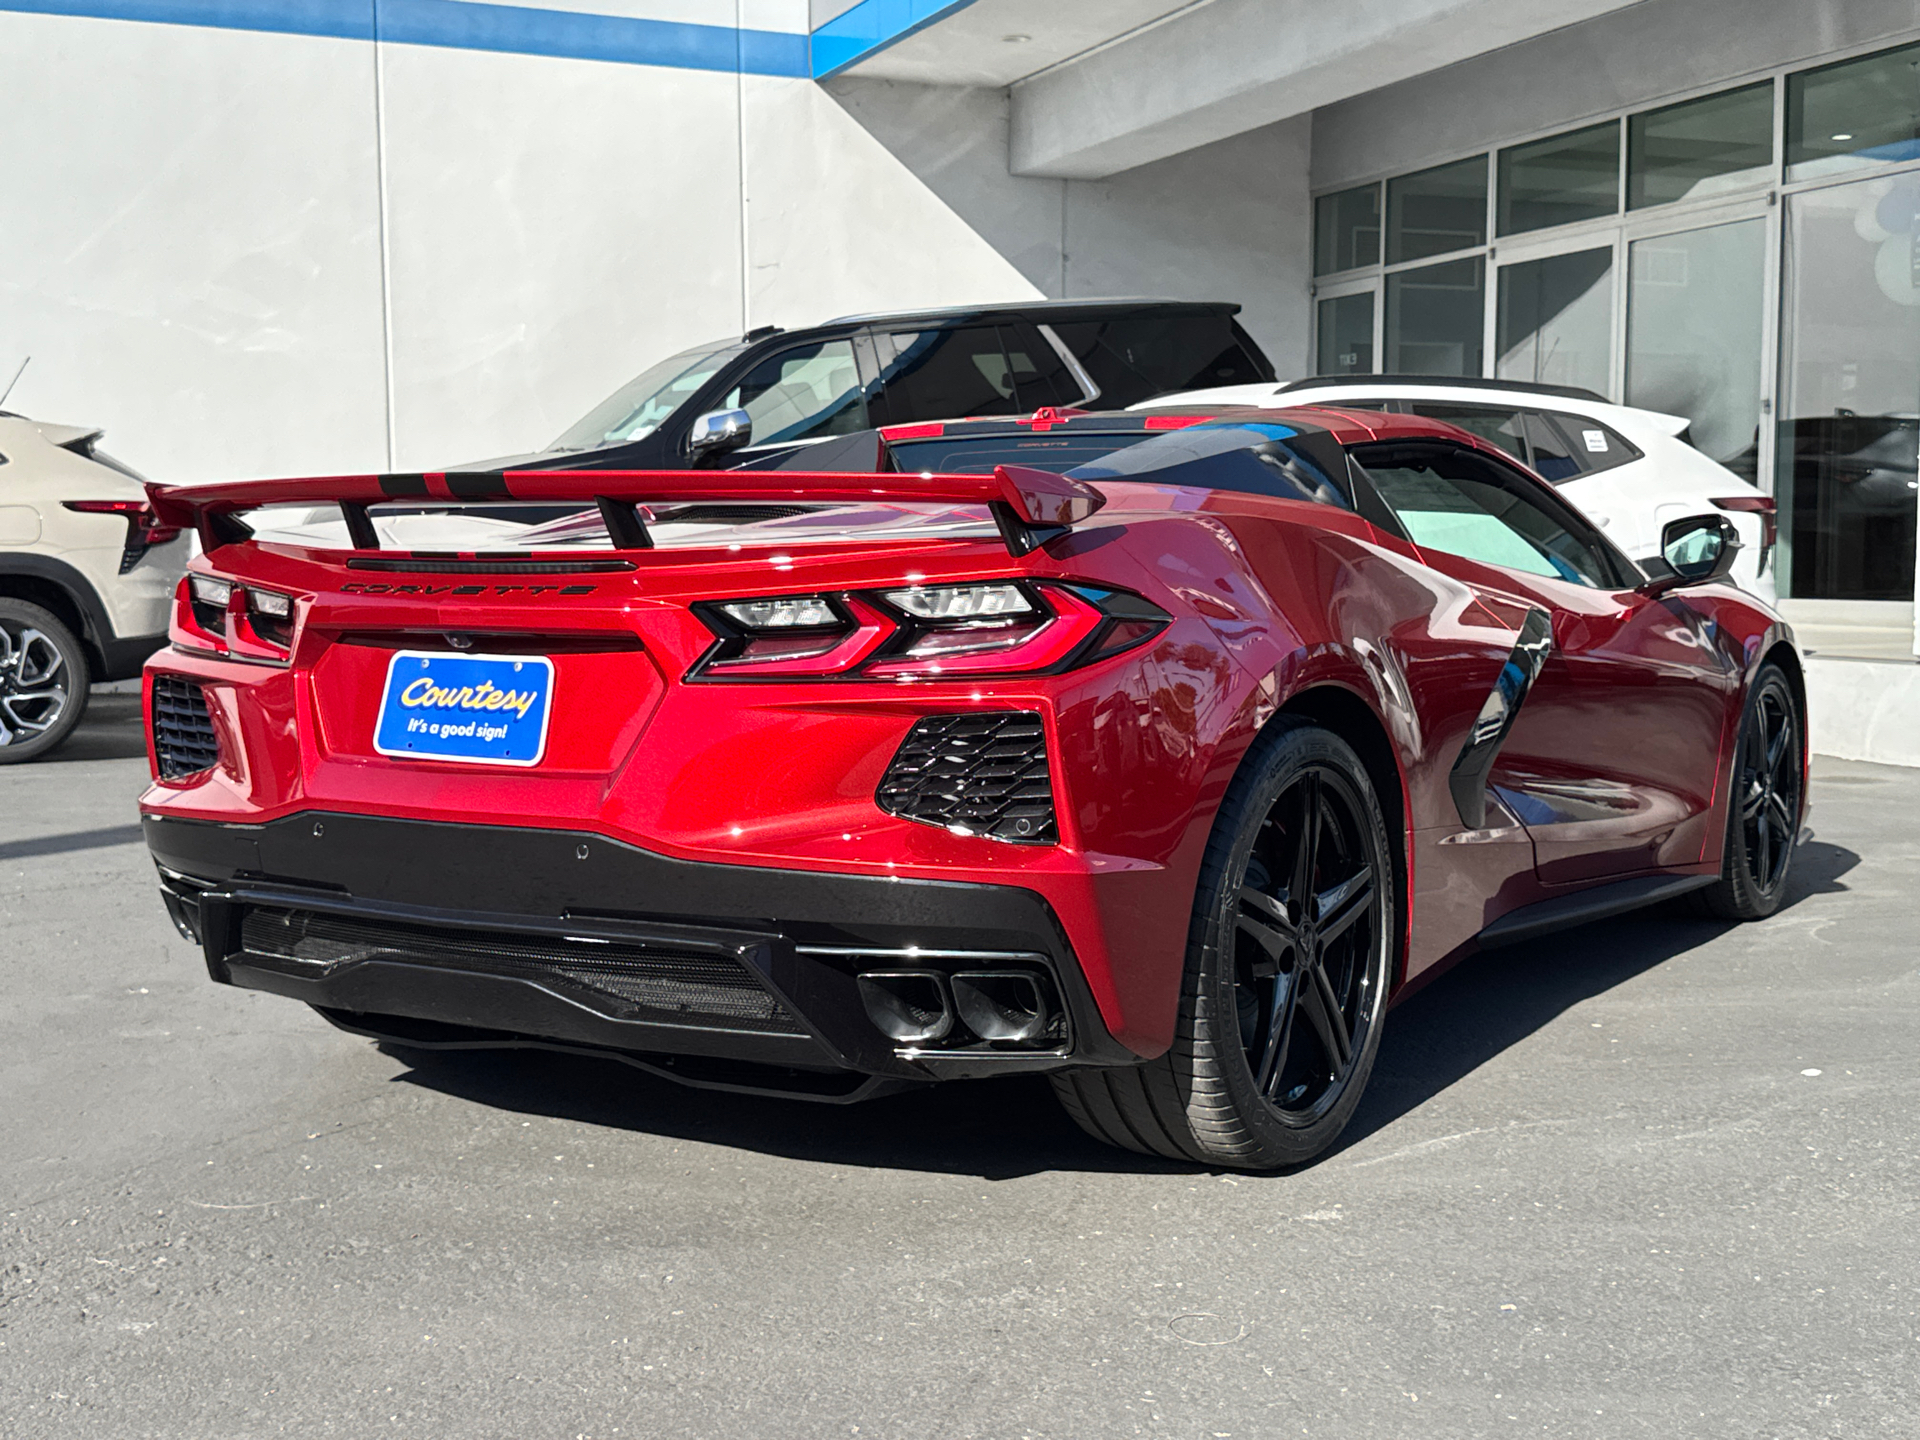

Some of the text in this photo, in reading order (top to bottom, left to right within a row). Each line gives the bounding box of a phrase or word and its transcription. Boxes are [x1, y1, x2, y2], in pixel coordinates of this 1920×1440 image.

[340, 583, 598, 595] CORVETTE
[401, 677, 537, 719] Courtesy
[407, 718, 508, 742] It's a good sign!
